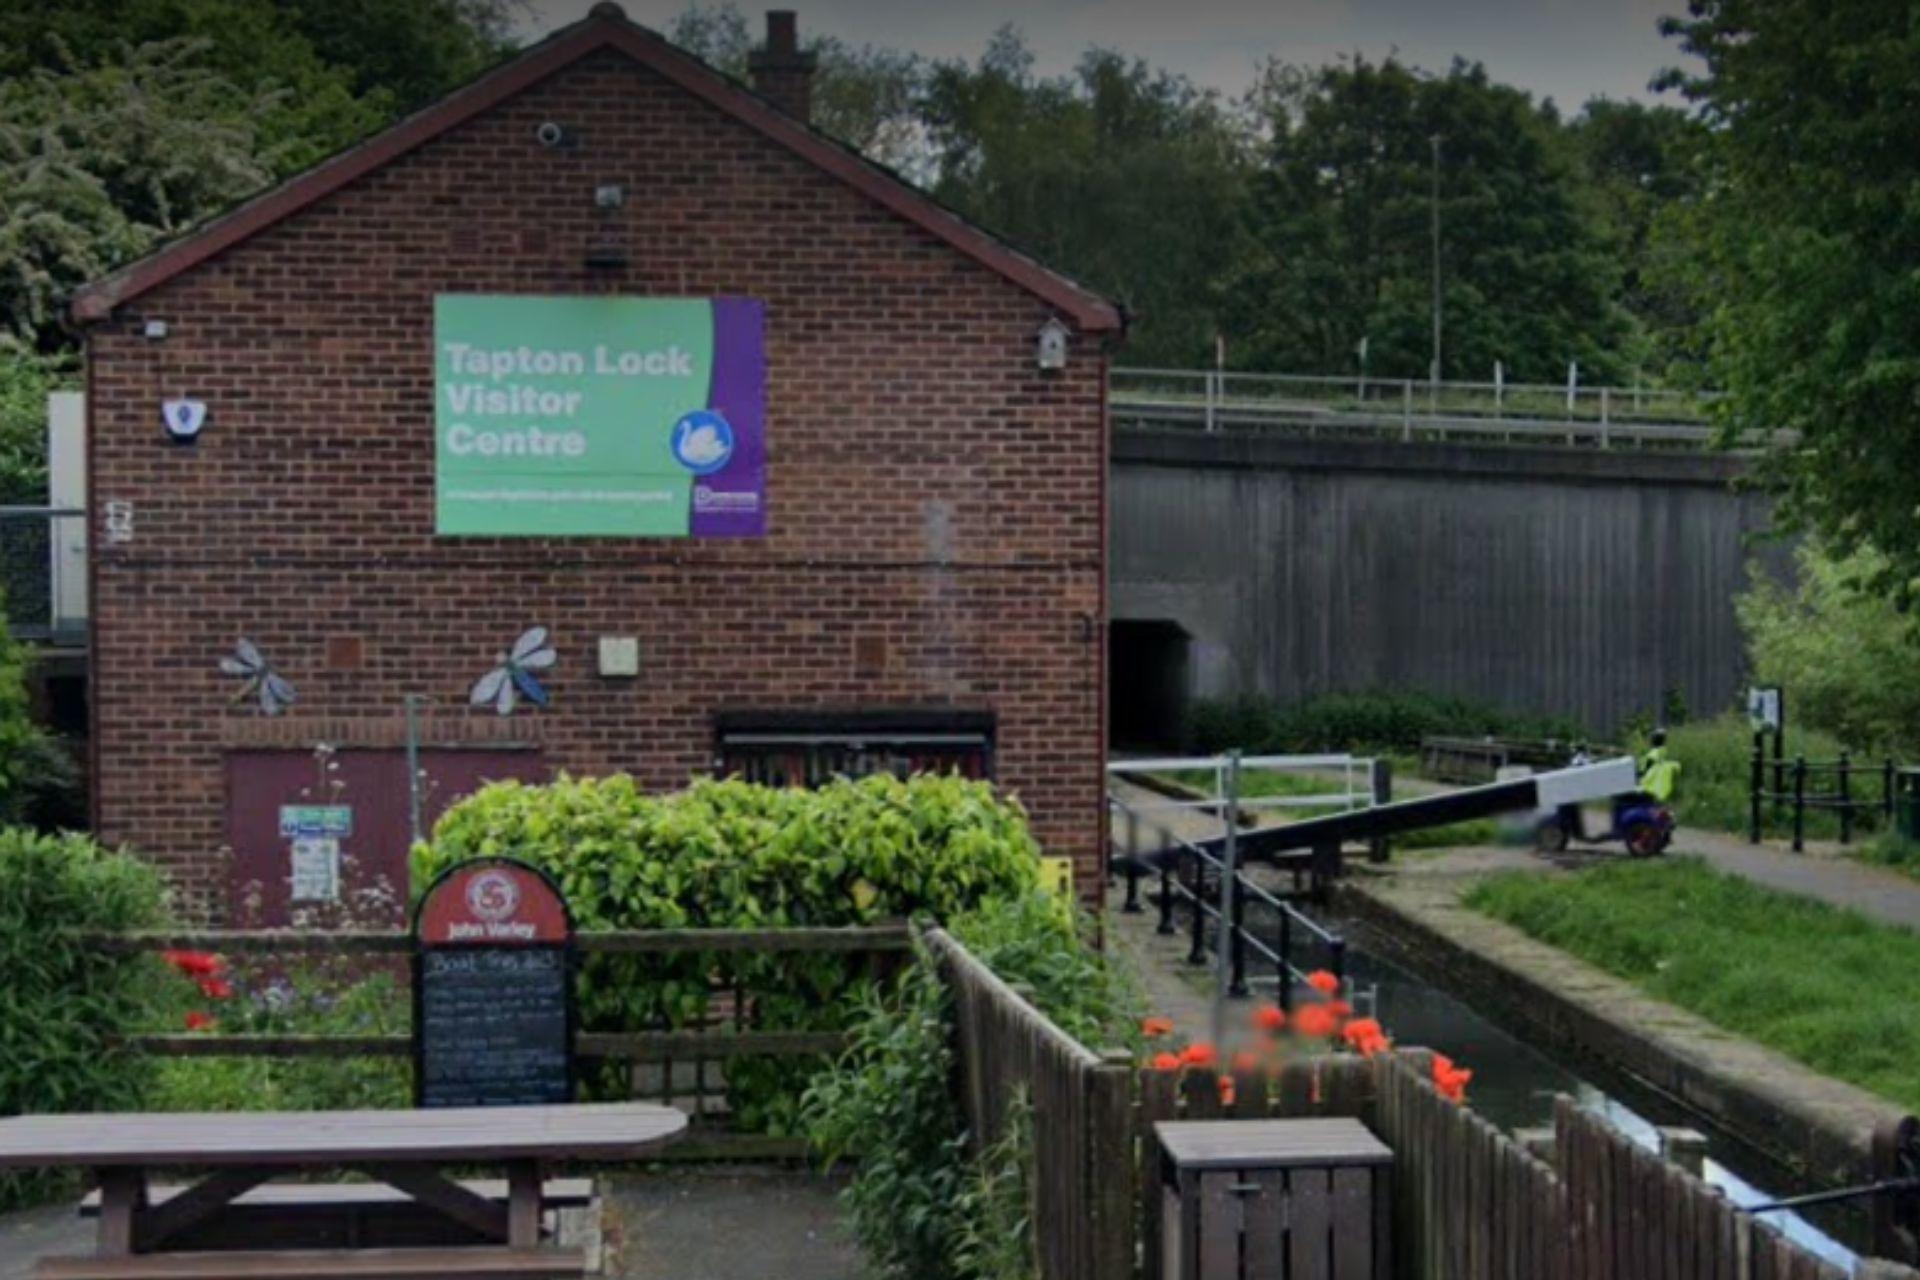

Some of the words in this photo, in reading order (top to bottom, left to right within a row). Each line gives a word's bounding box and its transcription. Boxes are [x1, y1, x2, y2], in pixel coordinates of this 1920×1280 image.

[445, 343, 584, 379] Tapton
[595, 345, 693, 375] Lock
[445, 383, 582, 414] Visitor
[447, 424, 587, 455] Centre
[448, 921, 485, 939] John
